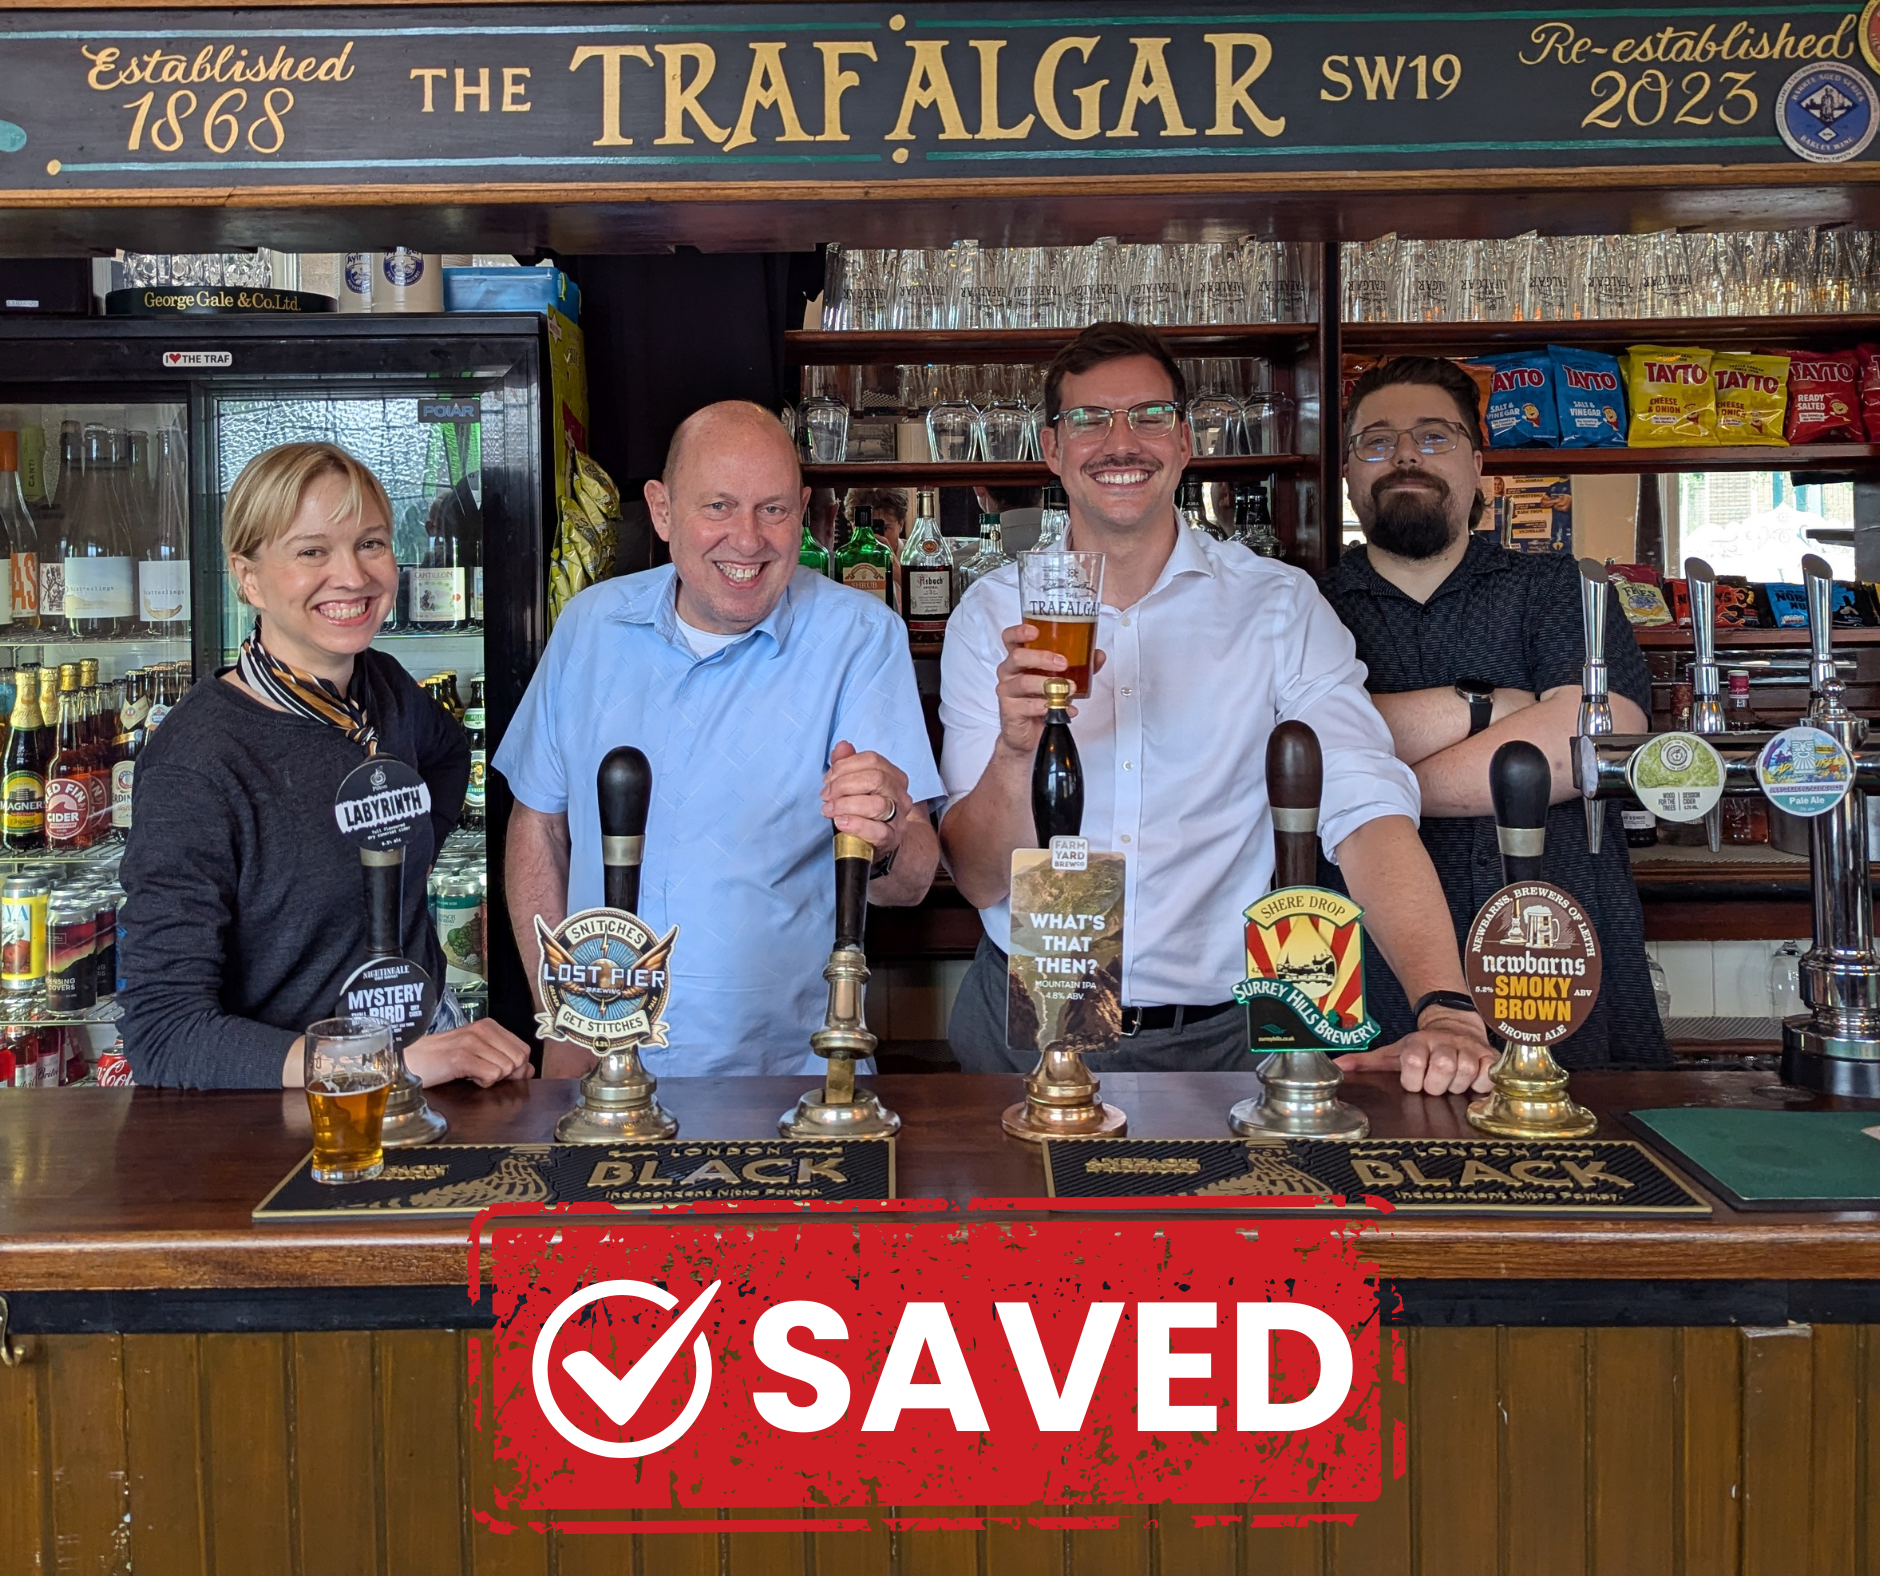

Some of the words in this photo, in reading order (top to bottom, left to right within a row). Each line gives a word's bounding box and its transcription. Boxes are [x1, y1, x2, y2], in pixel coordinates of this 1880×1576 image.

[1519, 14, 1857, 66] Re-established
[81, 41, 355, 90] Established
[409, 67, 531, 112] THE
[569, 33, 1286, 152] TRAFALGAR
[1320, 54, 1462, 101] SW19
[1581, 69, 1759, 128] 2023
[123, 87, 295, 154] 1868
[144, 291, 195, 310] George
[197, 290, 234, 307] Gale
[165, 354, 169, 363] I
[183, 354, 202, 364] THE
[204, 354, 230, 364] TRAF
[1491, 368, 1545, 393] AYTO
[1562, 365, 1617, 390] TAYTO
[1643, 362, 1708, 386] TAYTO
[1714, 370, 1780, 395] TAYTO
[1650, 396, 1678, 406] CHEESE
[1797, 402, 1826, 411] SALTED
[1798, 394, 1825, 402] READY
[423, 403, 474, 417] POLAR
[1490, 404, 1508, 413] SALT
[1570, 408, 1602, 417] VINEGAR
[1655, 406, 1681, 414] ONION
[851, 581, 878, 589] SHRUB
[65, 783, 86, 803] FIN
[1789, 797, 1810, 805] Pale
[1810, 796, 1825, 804] Ale
[47, 812, 79, 822] CIDER
[344, 789, 423, 828] LABYRINTH
[1055, 840, 1085, 850] FARM
[1055, 851, 1085, 860] YARD
[1260, 895, 1305, 919] SHERE
[1309, 896, 1346, 917] DROP
[1030, 913, 1106, 931] WHAT'S
[1472, 894, 1514, 953] NEWBARNS,
[1513, 886, 1570, 909] BREWERS
[1568, 907, 1584, 923] OF
[1578, 922, 1596, 957] LEITH
[571, 920, 645, 946] SNITCHES
[1042, 936, 1093, 952] THAT
[1034, 957, 1098, 975] THEN?
[1482, 950, 1586, 977] newbarns
[543, 963, 602, 983] LOST
[611, 968, 666, 988] PIER
[1035, 980, 1081, 989] MOUNTAIN
[1082, 981, 1097, 989] IPA
[348, 982, 424, 1010] MYSTERY
[548, 984, 561, 1008] GOLDEN
[586, 986, 622, 996] BREWING
[1046, 992, 1065, 1000] 4.8%
[1495, 975, 1572, 998] SMOKY
[1574, 989, 1592, 997] ABV
[647, 996, 659, 1010] PALE
[1232, 981, 1289, 1001] SURREY
[1286, 989, 1319, 1025] HILLS
[1314, 1018, 1376, 1045] BREWERY
[1494, 998, 1572, 1022] BROWN
[409, 1010, 422, 1018] CIDER
[563, 1011, 585, 1028] GET
[587, 1017, 644, 1033] STITCHES
[1498, 1021, 1541, 1043] BROWN
[1544, 1024, 1567, 1041] ALE
[671, 1147, 782, 1156] LONDON
[1412, 1147, 1530, 1157] LONDON
[587, 1158, 848, 1187] BLACK
[1351, 1159, 1635, 1187] BLACK
